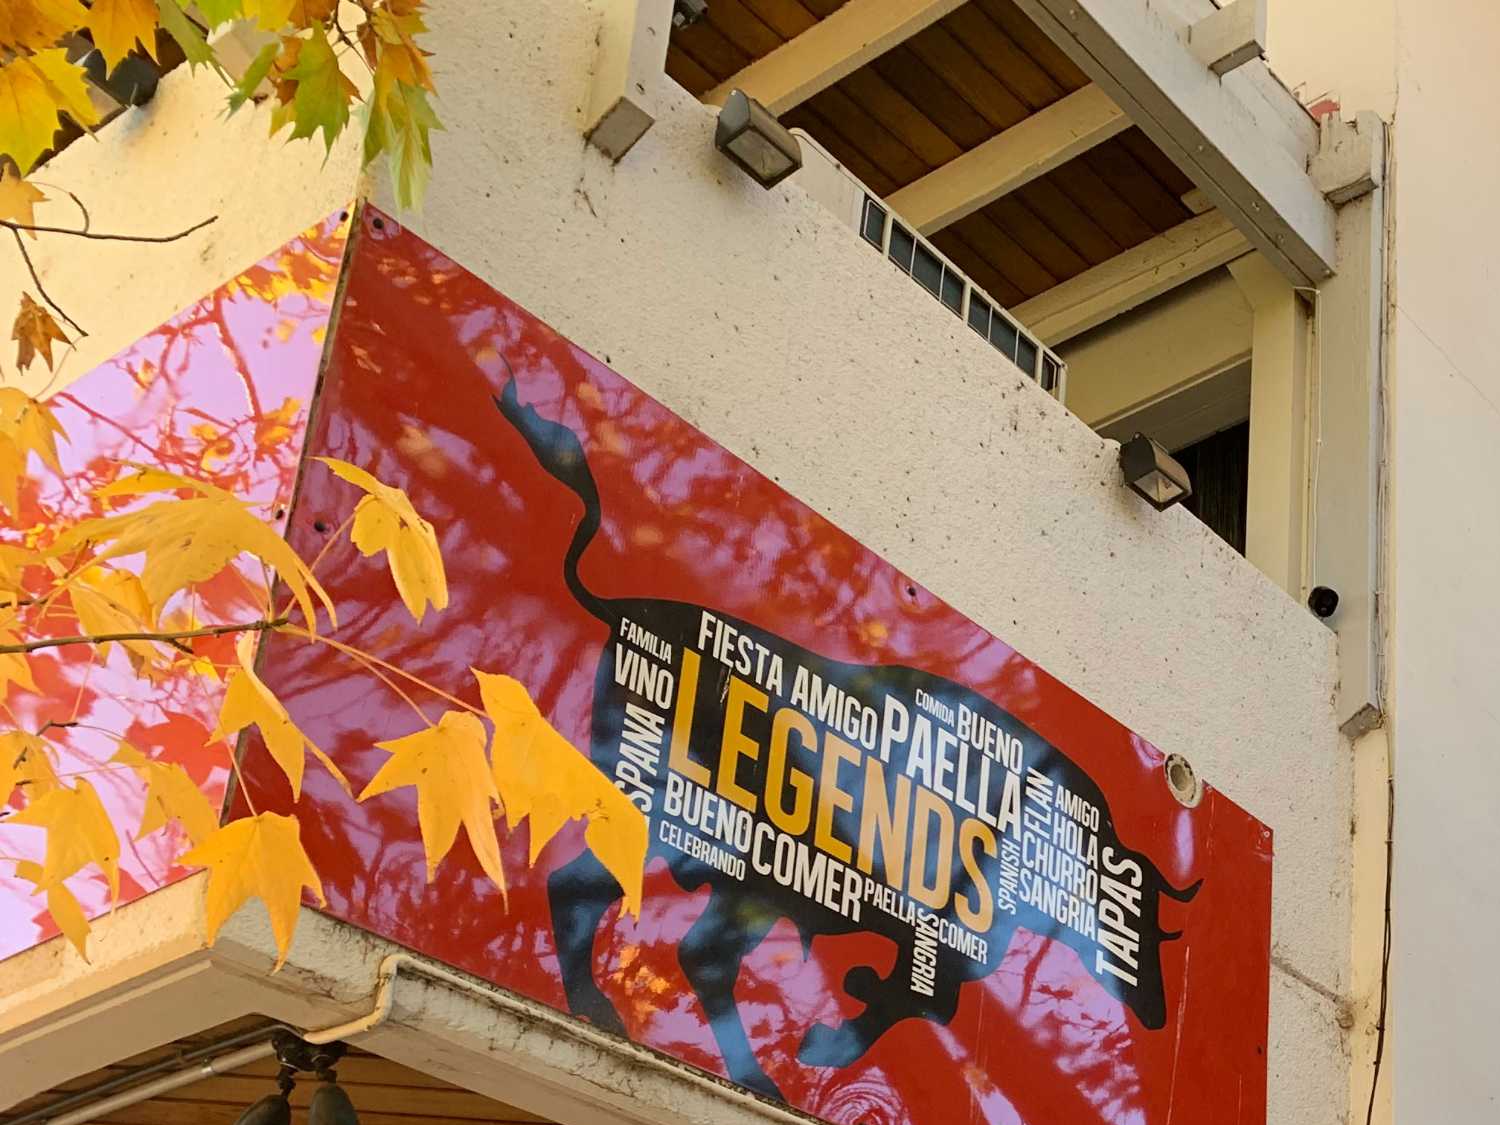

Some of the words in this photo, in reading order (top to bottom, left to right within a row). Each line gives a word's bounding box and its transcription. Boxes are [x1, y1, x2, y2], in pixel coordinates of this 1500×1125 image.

[614, 643, 674, 710] VINO
[620, 617, 672, 664] FAMILIA
[698, 610, 783, 697] FIESTA
[790, 665, 878, 751] AMIGO
[614, 702, 665, 828] SPANA
[880, 694, 1022, 842] PAELLA
[915, 688, 955, 728] COMIDA
[957, 703, 1024, 774] BUENO
[668, 647, 998, 934] LEGENDS
[1024, 766, 1055, 840] FLAN
[1053, 784, 1100, 833] AMIGO
[659, 821, 746, 882] CELEBRANDO
[663, 772, 753, 854] BUENO
[751, 821, 865, 923] COMER
[998, 838, 1021, 916] SPANISH
[1021, 832, 1099, 907] CHURRO
[1053, 811, 1099, 871] HOLA
[864, 877, 918, 927] PAELLA
[938, 916, 988, 965] COMER
[1018, 867, 1099, 943] SANGRIA
[1095, 846, 1143, 988] TAPAS
[910, 907, 940, 997] SANGRIA
